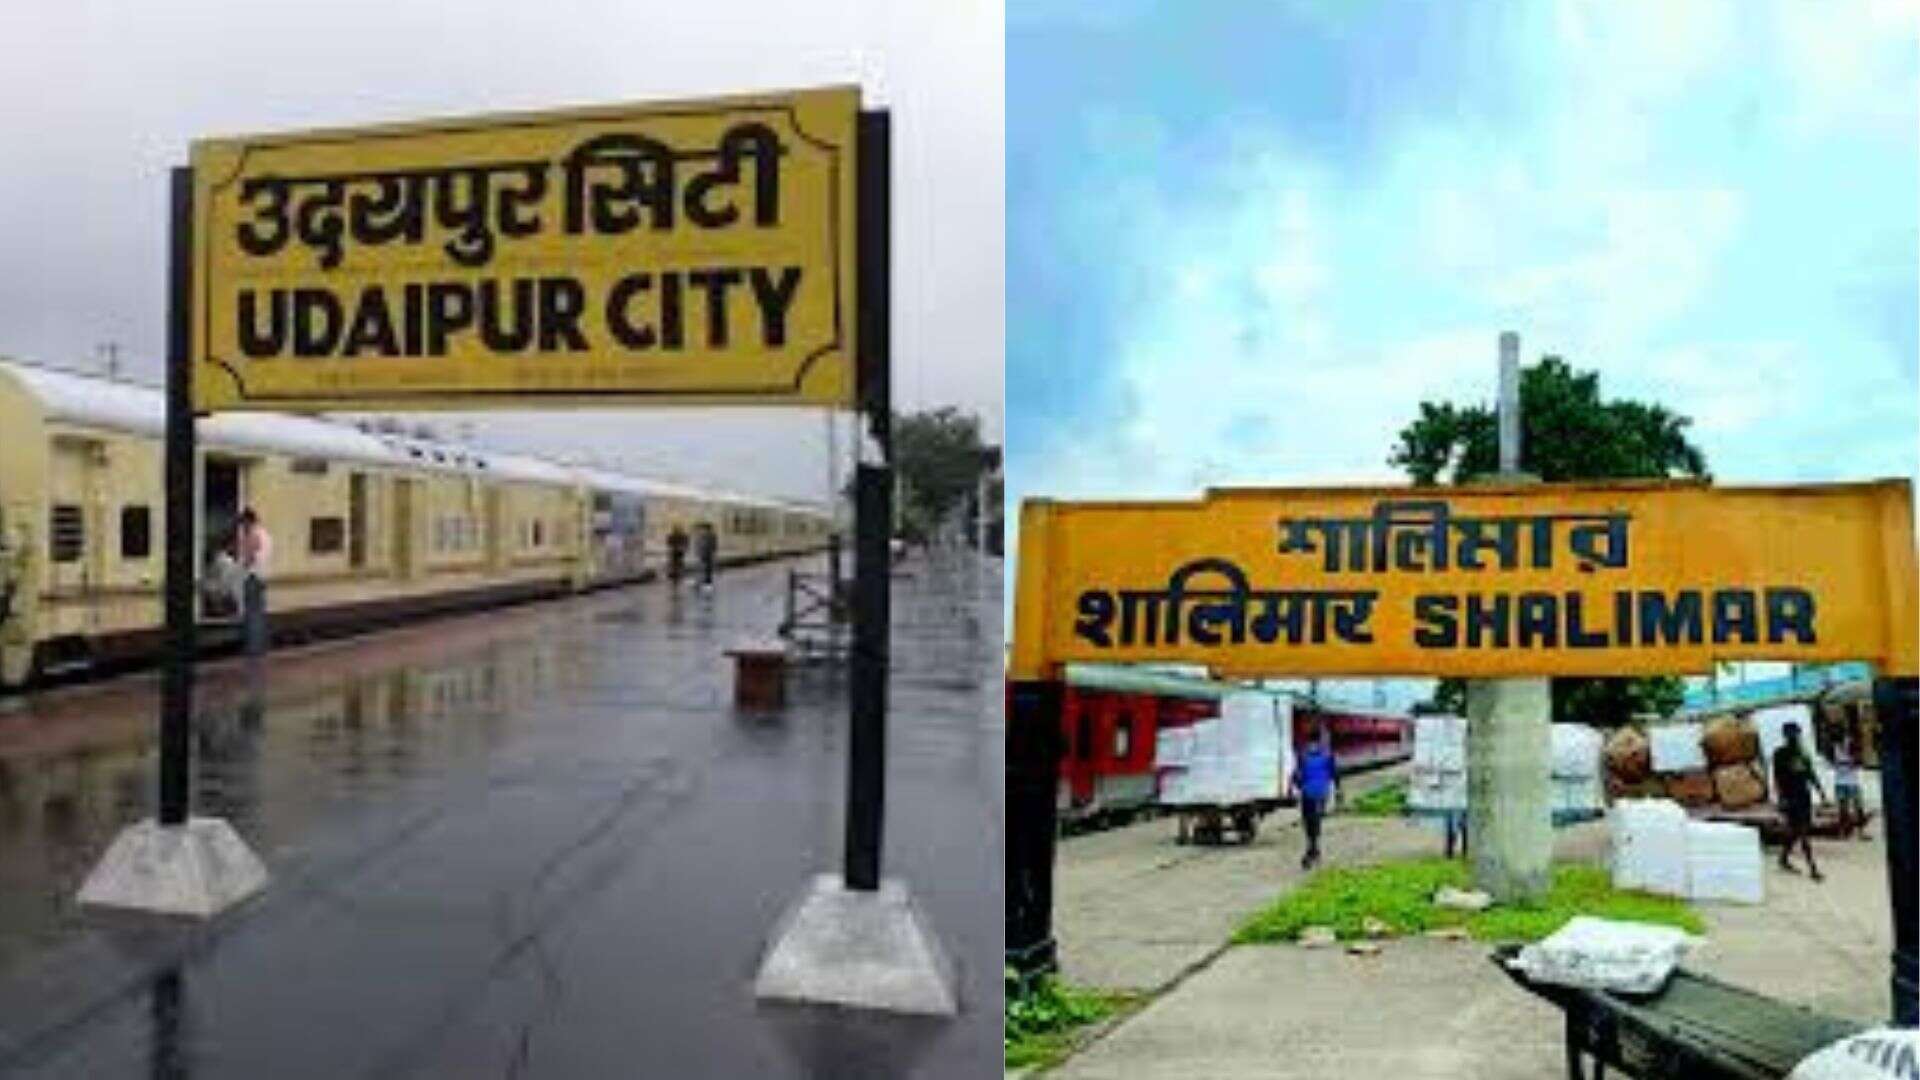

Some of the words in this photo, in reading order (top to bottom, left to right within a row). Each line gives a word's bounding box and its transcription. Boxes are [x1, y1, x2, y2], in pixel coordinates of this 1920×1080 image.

[237, 159, 550, 272] उदयपुर
[560, 121, 789, 237] सिटी
[237, 276, 591, 360] UDAIPUR
[605, 266, 802, 351] CITY
[1278, 501, 1633, 573] শালিমার
[1073, 557, 1380, 648] शालिमार
[1413, 587, 1818, 649] SHALIMAR
